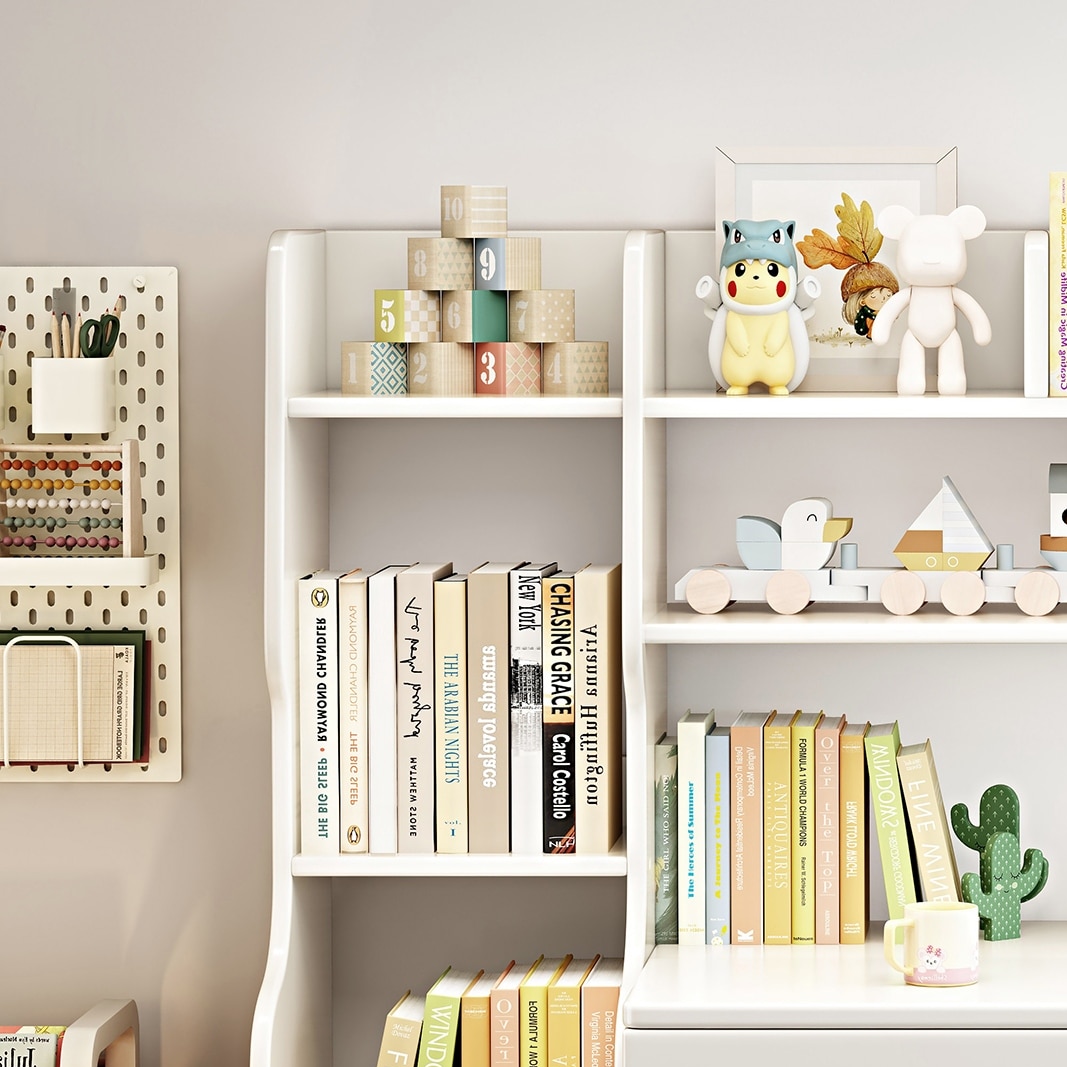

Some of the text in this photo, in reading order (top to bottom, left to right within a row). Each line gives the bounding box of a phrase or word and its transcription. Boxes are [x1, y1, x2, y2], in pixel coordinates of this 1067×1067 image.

[443, 197, 464, 221] 10
[413, 250, 428, 277] 8
[479, 247, 496, 281] 9
[380, 299, 396, 333] 5
[447, 302, 461, 329] 6
[515, 301, 529, 333] 7
[348, 352, 358, 384] 1
[413, 352, 428, 384] 2
[480, 352, 496, 385] 3
[547, 352, 563, 384] 4
[518, 576, 541, 631] New York
[550, 583, 571, 714] CHASING GRACE
[444, 654, 460, 783] THE ARABIAN NIGHTS
[799, 739, 807, 772] FORMULA
[553, 734, 571, 819] Carol Costello
[799, 779, 807, 804] WORLD
[687, 781, 695, 827] Summer
[773, 782, 789, 889] ANTIQUAIRES
[799, 806, 807, 846] CHAMPIONS
[662, 796, 670, 895] THE GIRL WHO SAID
[687, 879, 695, 898] The
[589, 1012, 600, 1040] Virginia
[605, 1010, 614, 1033] Detail
[605, 1034, 613, 1042] in
